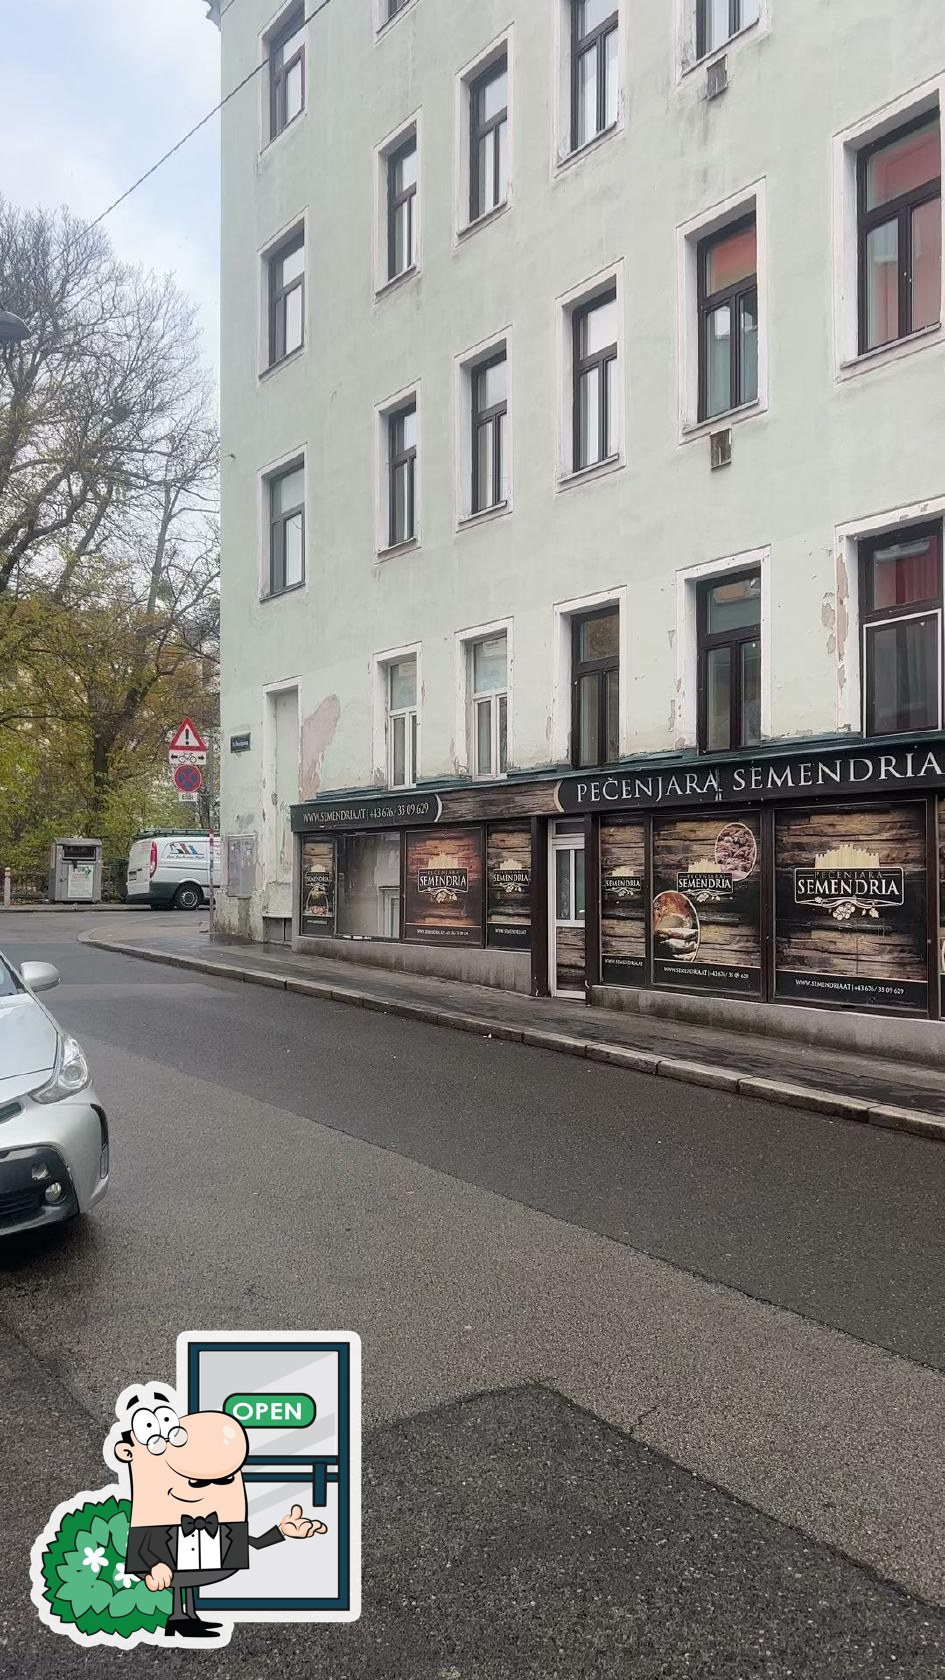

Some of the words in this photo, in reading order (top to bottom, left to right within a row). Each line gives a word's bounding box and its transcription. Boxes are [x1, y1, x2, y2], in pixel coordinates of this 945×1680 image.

[577, 771, 718, 802] PEČENJARA
[733, 752, 945, 790] SEMENDRIA
[419, 875, 466, 887] SEMENDRIA
[493, 873, 529, 882] SEMENDRIA
[678, 879, 731, 889] SEMENDRIA
[797, 879, 900, 895] SEMENDRIA
